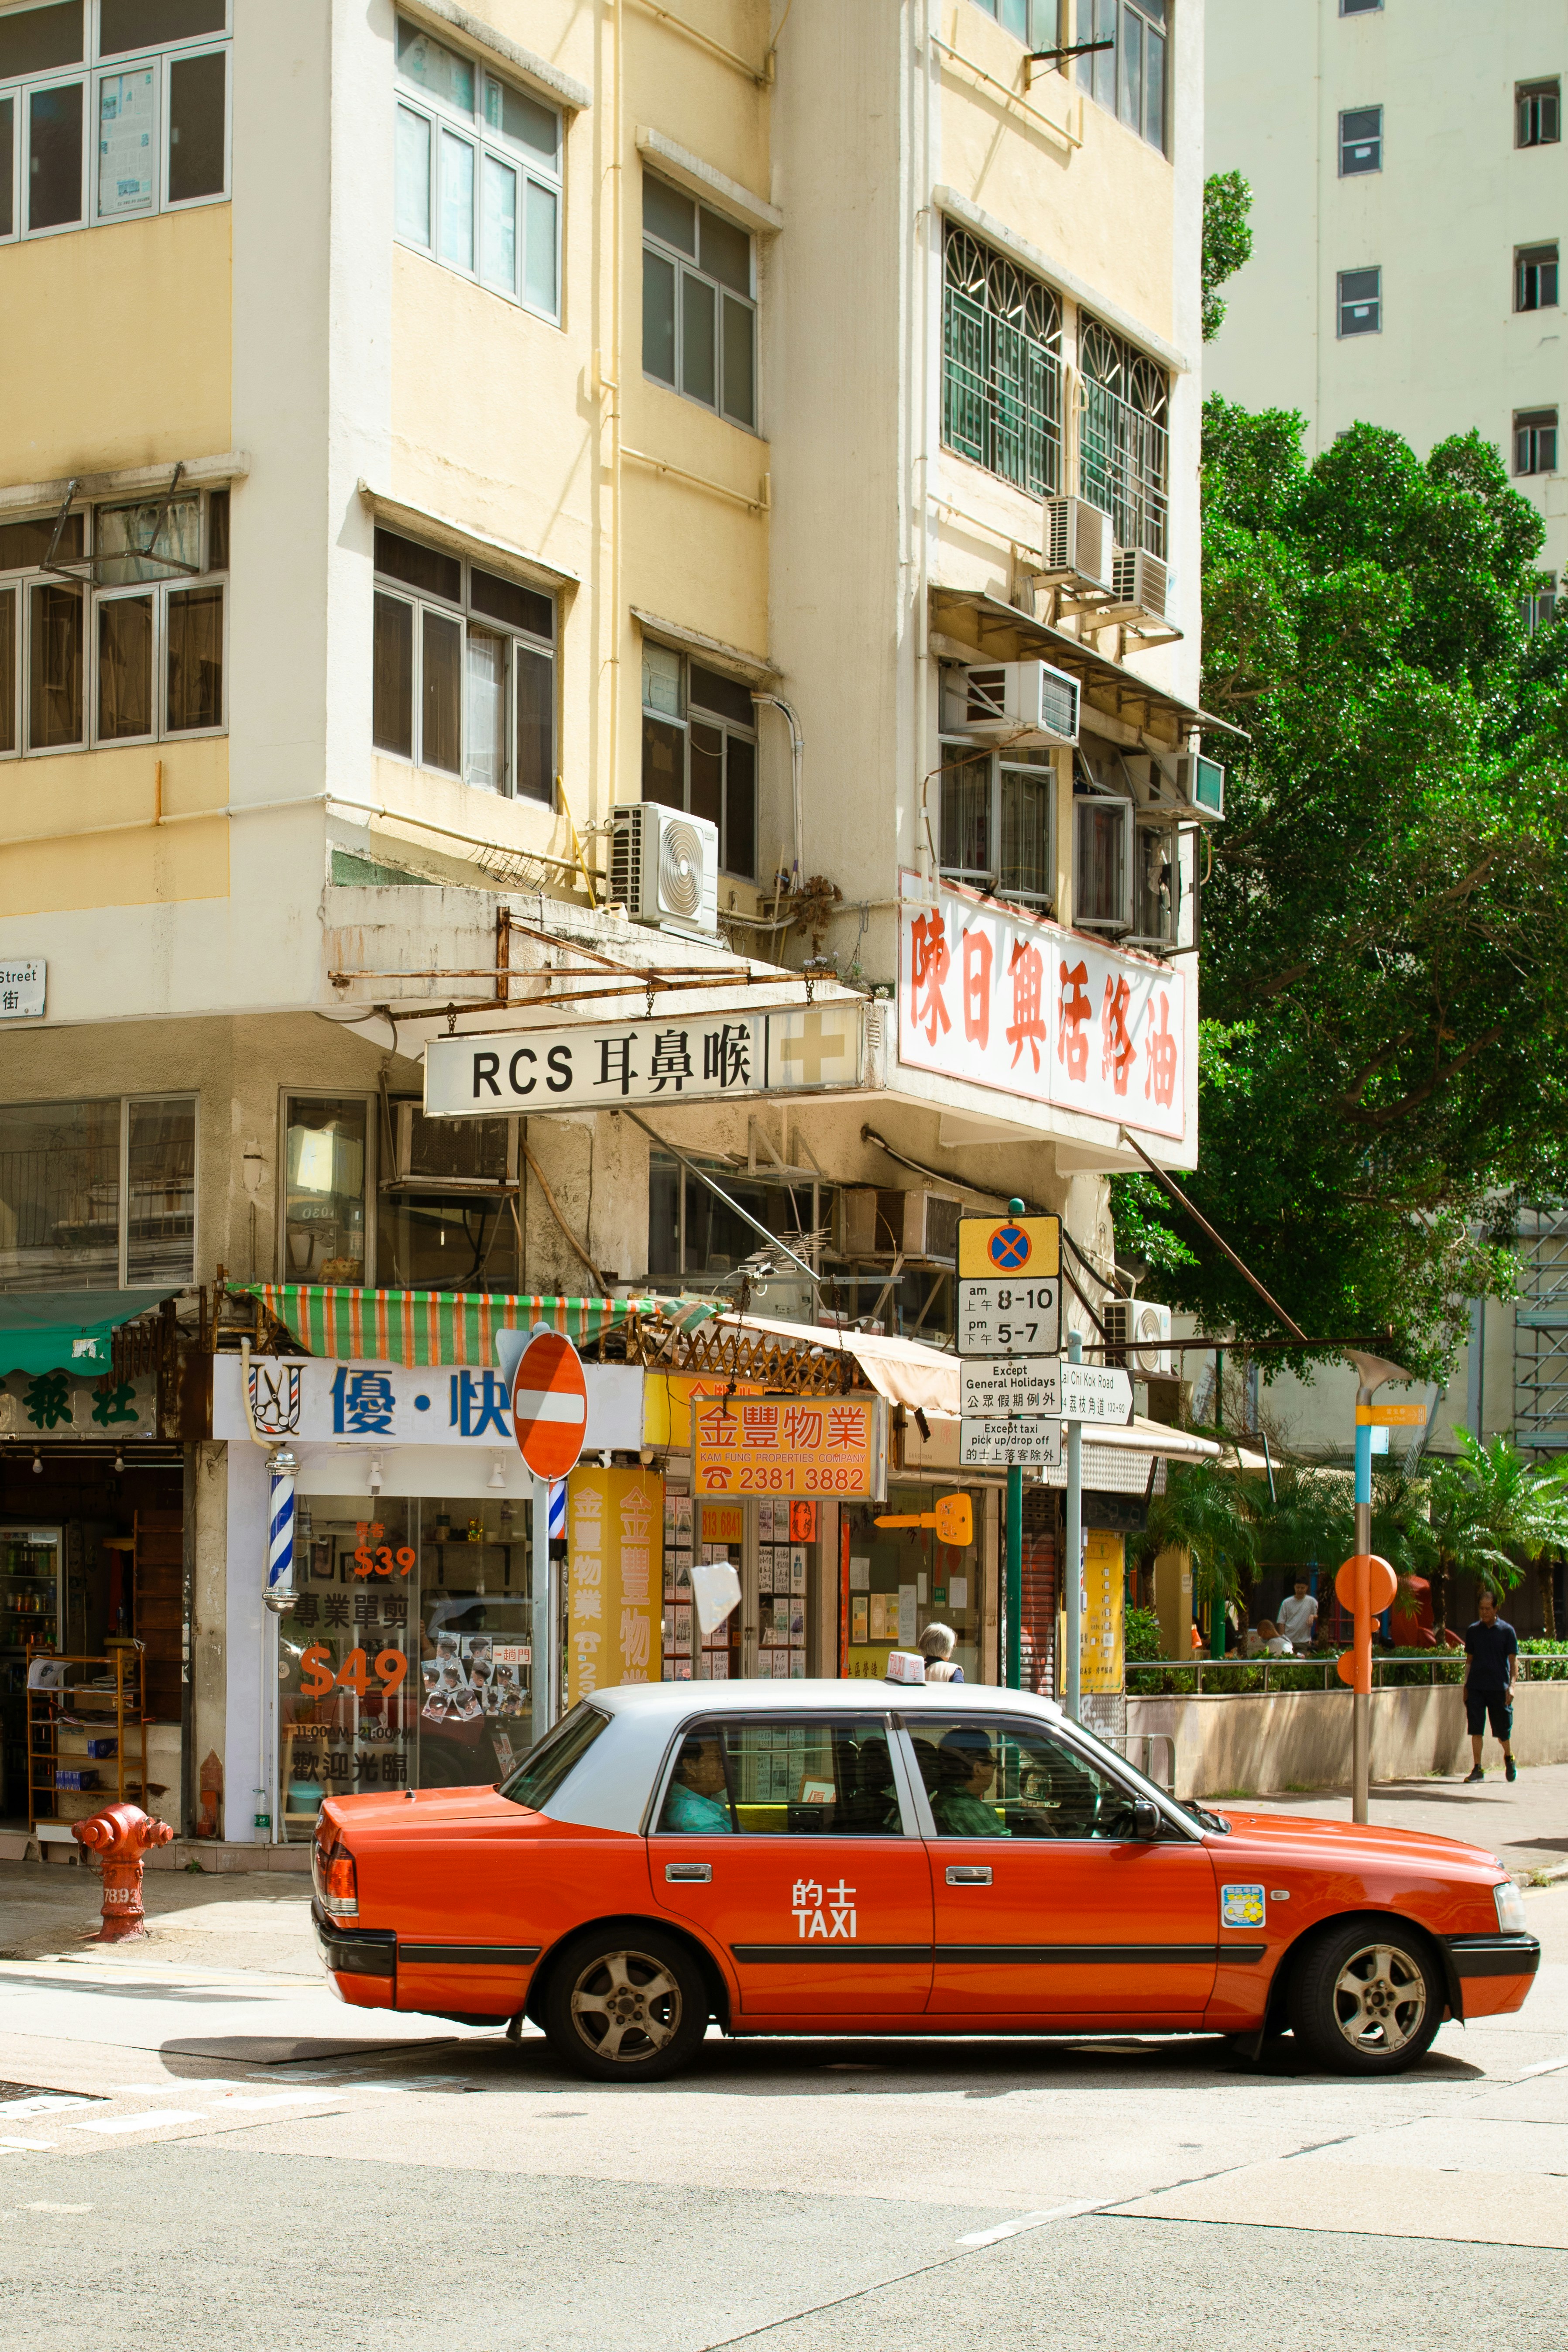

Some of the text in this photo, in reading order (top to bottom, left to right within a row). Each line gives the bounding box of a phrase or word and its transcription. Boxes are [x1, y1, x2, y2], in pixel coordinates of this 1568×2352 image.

[0, 969, 37, 983] Street
[3, 990, 19, 1010] 街
[911, 908, 1177, 1110] 陳日興活絡油
[593, 1023, 751, 1095] 耳鼻喉
[473, 1045, 573, 1097] RCS
[964, 1299, 992, 1312] 上午
[969, 1286, 1053, 1310] am 8-10
[964, 1333, 992, 1346] 下午
[969, 1320, 1038, 1343] pm 5-7
[966, 1376, 1055, 1389] General Holidays
[993, 1366, 1028, 1377] Except
[1071, 1371, 1081, 1385] Chi
[1084, 1372, 1096, 1387] Kok
[1098, 1374, 1114, 1389] Road
[1070, 1395, 1104, 1416] 荔枝角道
[699, 1405, 866, 1450] 金豐物業
[985, 1423, 1038, 1435] Except taxi
[971, 1435, 1050, 1447] pick up/drop off
[700, 1453, 866, 1463] KAM FUNG PROPERTIES COMPANY
[966, 1448, 1054, 1461] 的士上落客除外
[739, 1467, 864, 1491] 2381 3882
[355, 1522, 385, 1538] 長者
[354, 1546, 415, 1578] $39
[573, 1487, 603, 1620] 金豐物業
[620, 1486, 652, 1685] 金豐物
[293, 1593, 409, 1629] 專業單剪
[503, 1649, 529, 1661] 趟門
[889, 1654, 905, 1677] TAXI
[300, 1641, 408, 1701] $49
[909, 1661, 920, 1677] 的士
[292, 1751, 408, 1783] 歡迎光臨
[793, 1879, 856, 1907] 的士
[792, 1910, 856, 1938] TAXI
